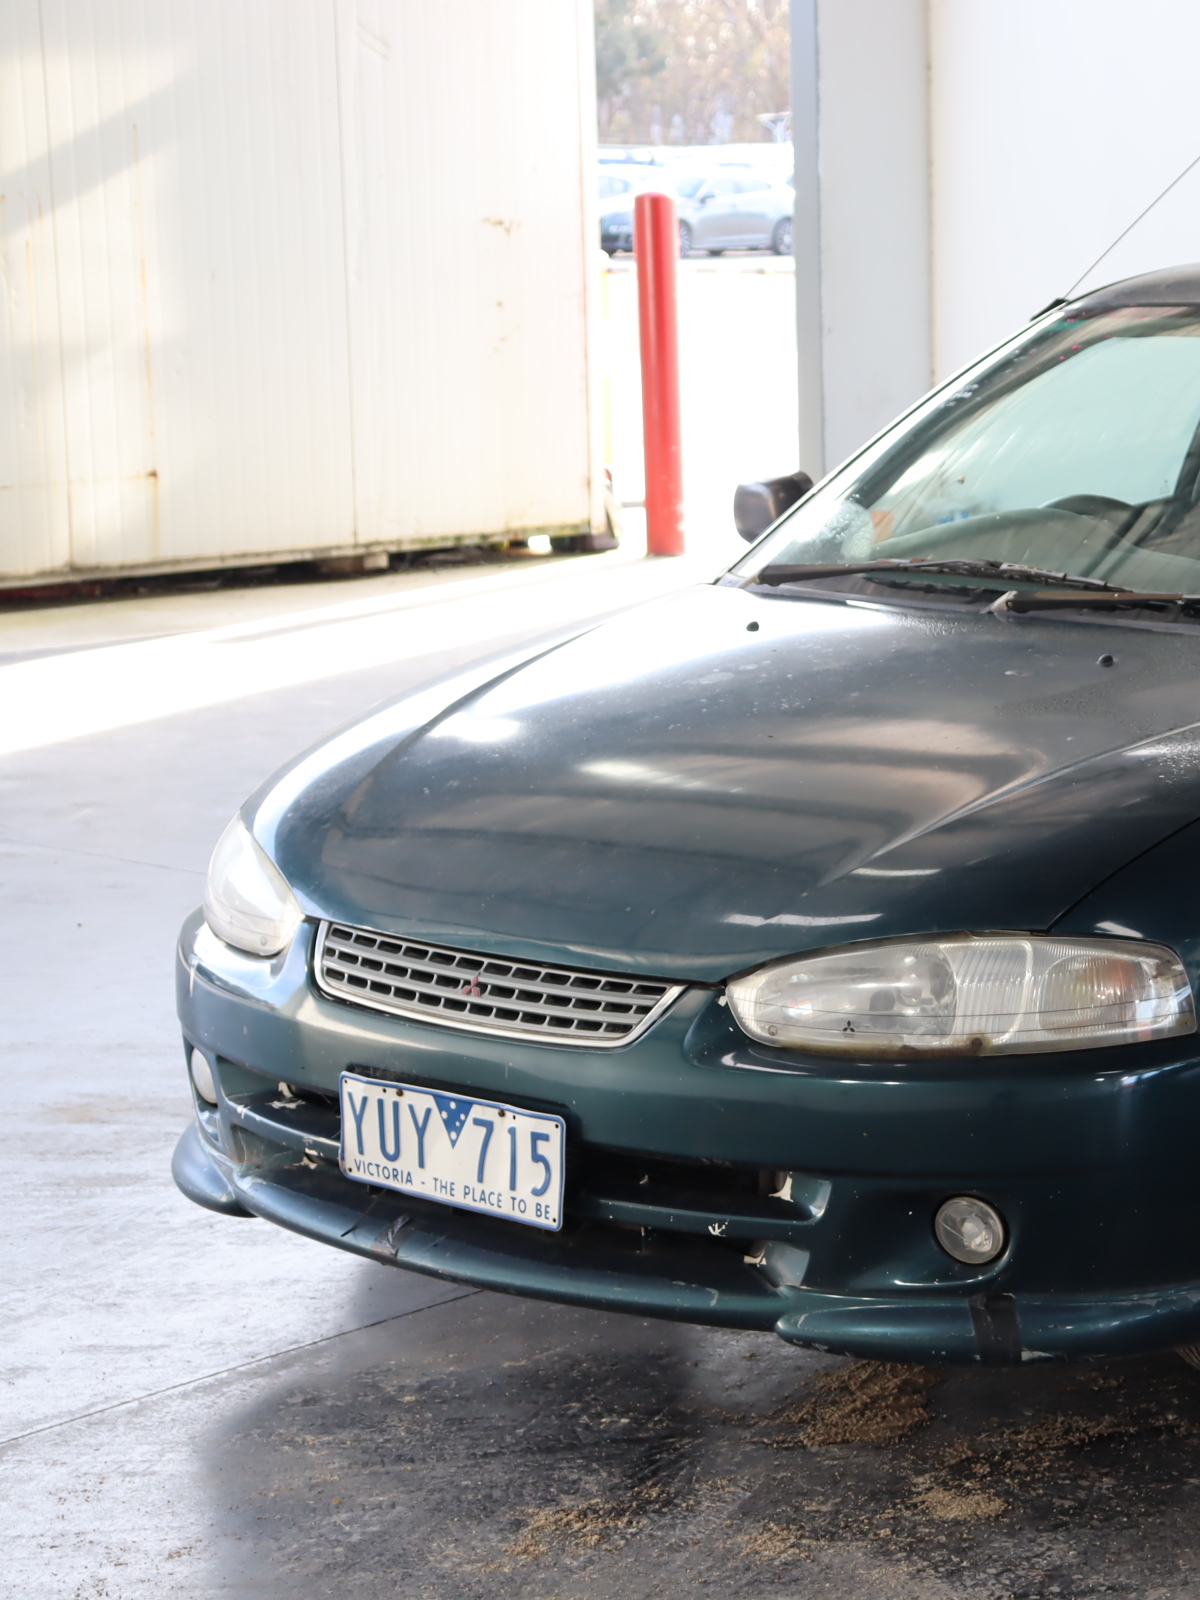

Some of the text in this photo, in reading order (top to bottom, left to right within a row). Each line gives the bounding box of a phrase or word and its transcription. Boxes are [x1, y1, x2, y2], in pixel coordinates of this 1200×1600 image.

[347, 1091, 552, 1196] YUY 715
[354, 1159, 413, 1186] VICTORIA
[433, 1177, 455, 1197] THE
[463, 1185, 503, 1209] PLACE
[510, 1196, 527, 1214] TO
[535, 1204, 550, 1220] BE
